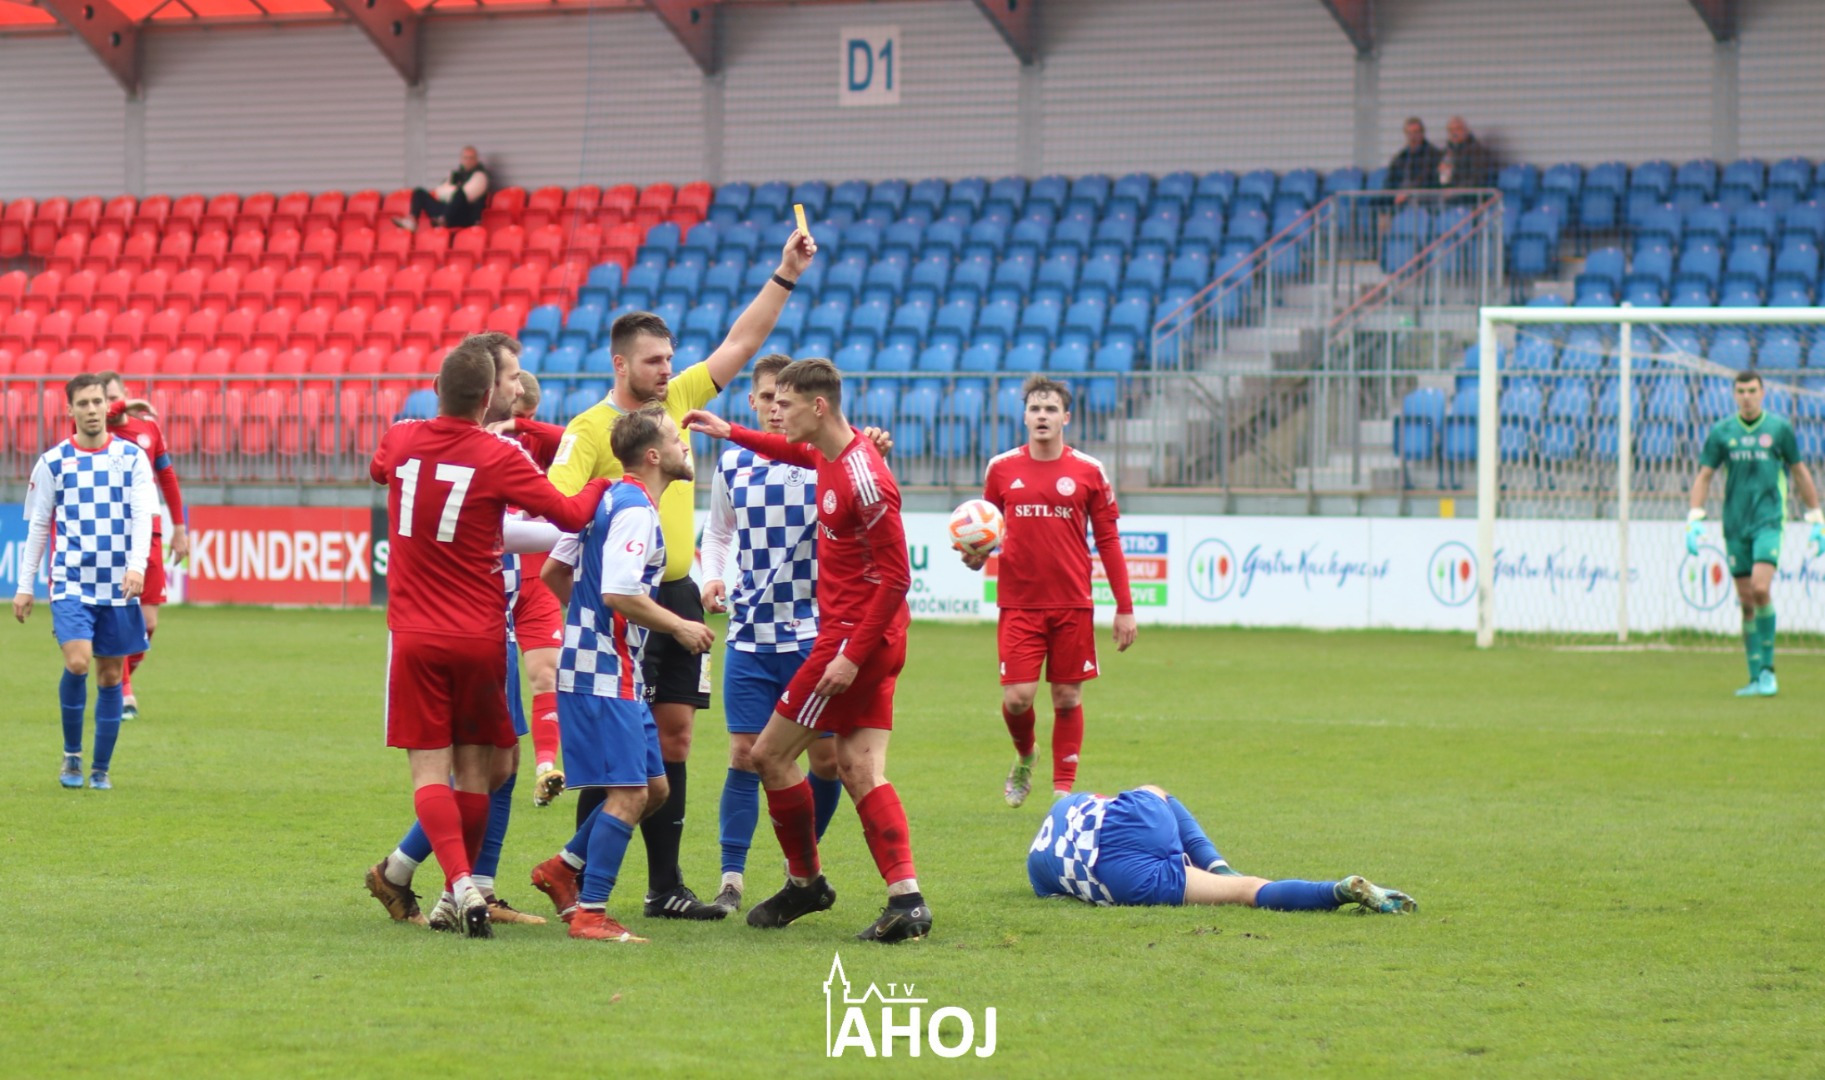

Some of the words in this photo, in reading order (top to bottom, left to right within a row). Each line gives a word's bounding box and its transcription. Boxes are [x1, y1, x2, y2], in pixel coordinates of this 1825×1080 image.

[847, 38, 893, 91] D1
[395, 457, 476, 543] 17
[188, 529, 370, 582] KUNDREX
